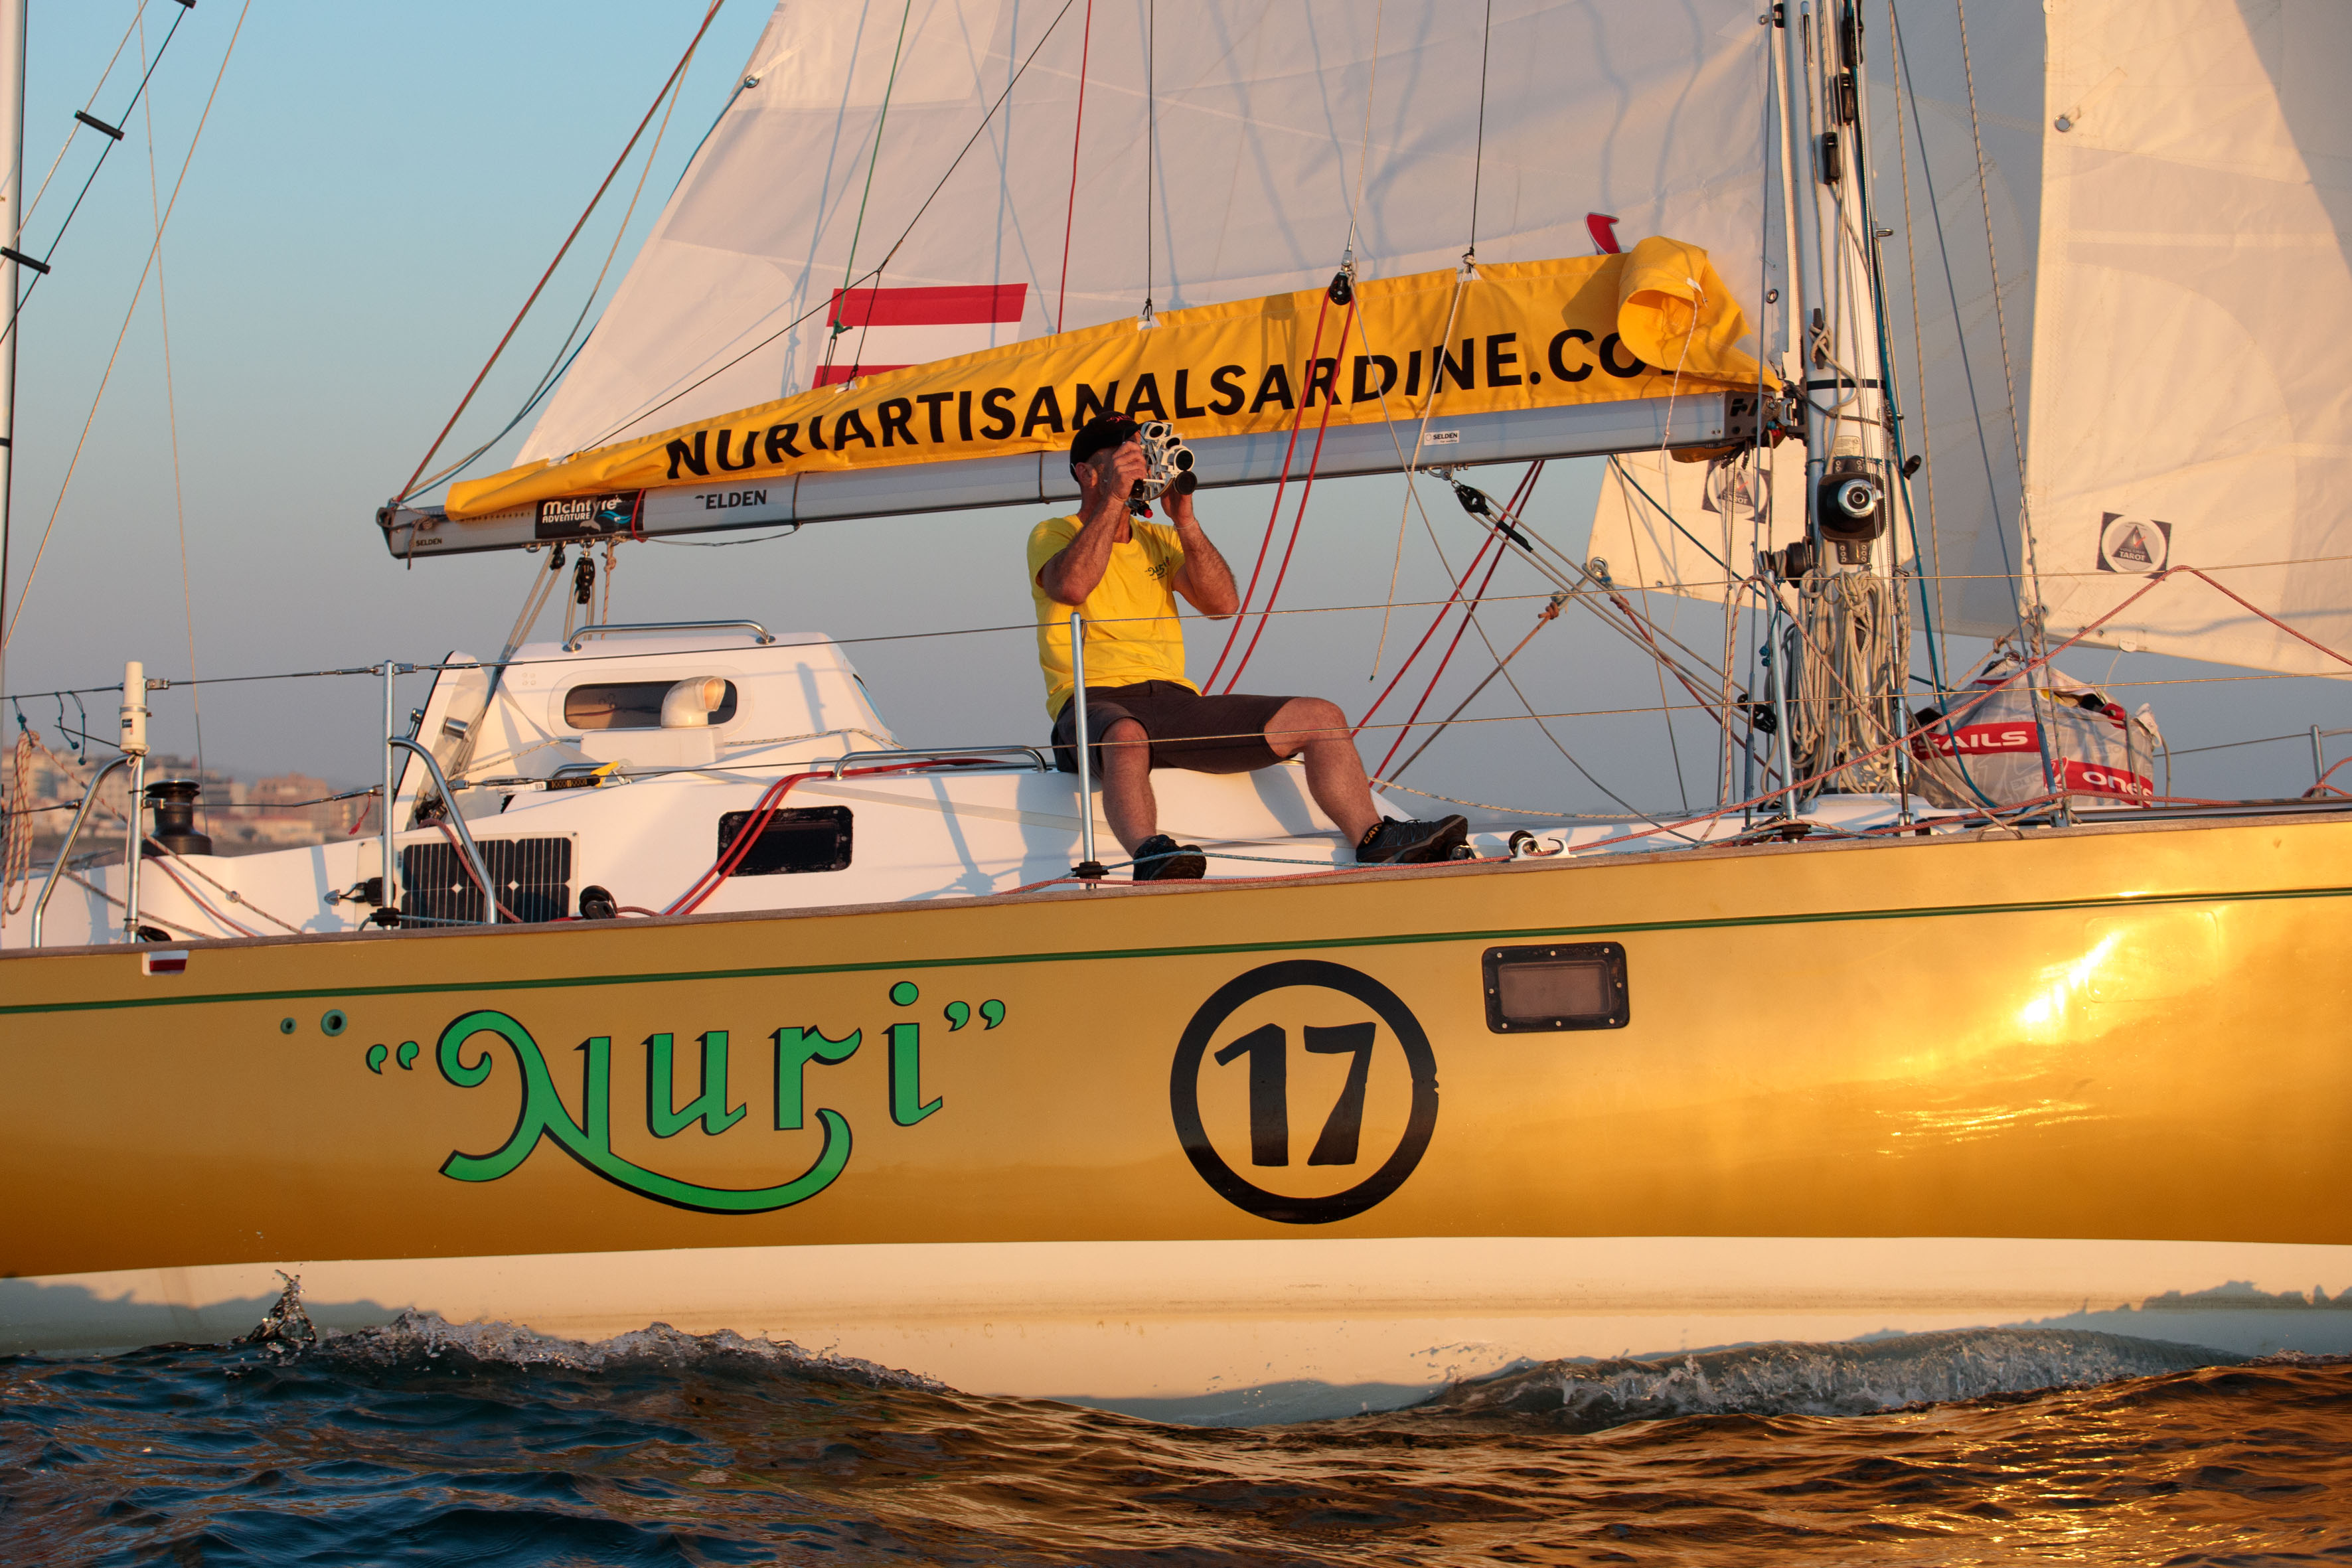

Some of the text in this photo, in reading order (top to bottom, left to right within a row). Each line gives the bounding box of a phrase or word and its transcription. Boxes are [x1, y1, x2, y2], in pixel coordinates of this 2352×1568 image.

[666, 329, 1674, 479] NURIARTISANALSARDINE.CO
[694, 489, 767, 510] ELDEN
[542, 512, 591, 524] ADVENTURE
[2119, 551, 2146, 561] TAROT
[1214, 1022, 1376, 1166] 17
